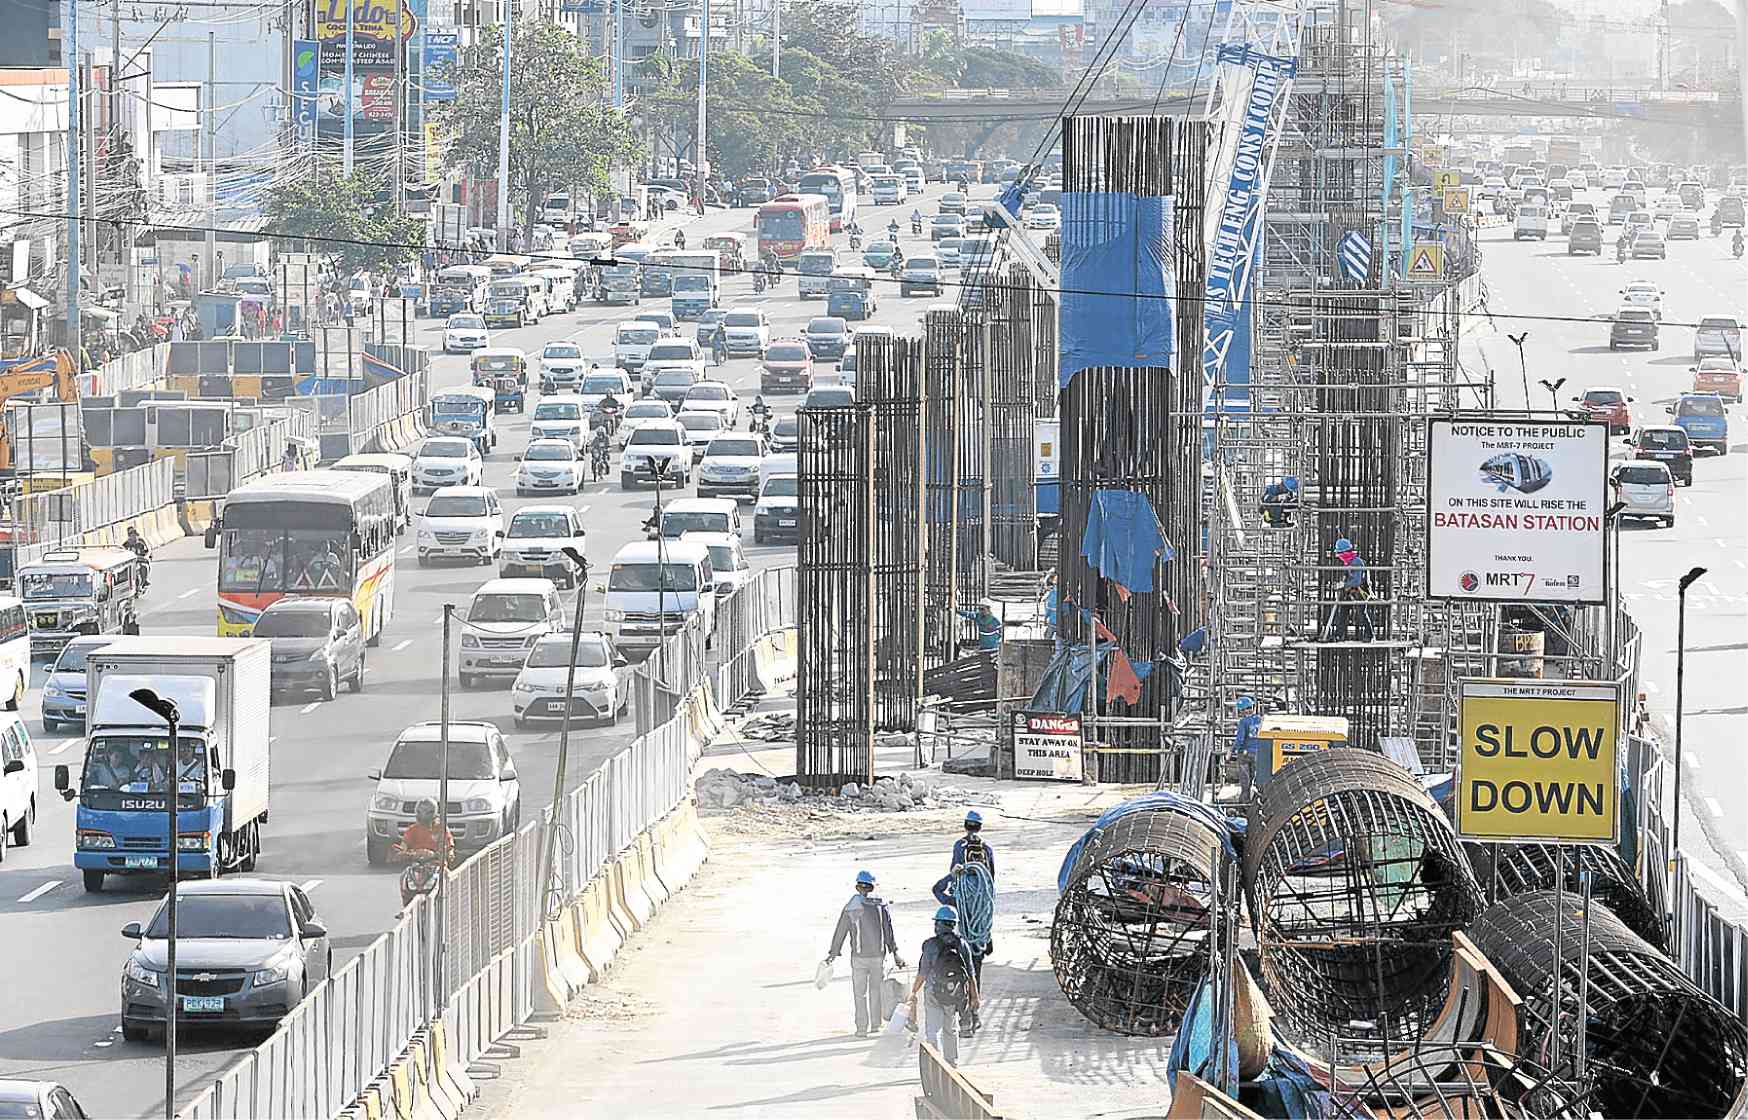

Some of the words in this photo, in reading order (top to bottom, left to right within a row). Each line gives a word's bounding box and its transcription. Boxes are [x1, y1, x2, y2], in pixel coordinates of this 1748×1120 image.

[326, 0, 386, 22] Ldo
[1451, 426, 1494, 437] NOTICE
[1498, 427, 1513, 437] TO
[1515, 427, 1538, 437] THE
[1541, 426, 1585, 438] PUBLIC
[1522, 442, 1554, 450] PROJECT
[1448, 498, 1463, 507] ON
[1466, 498, 1488, 507] THIS
[1490, 499, 1512, 508] SITE
[1514, 499, 1538, 509] WILL
[1541, 500, 1564, 509] RISE
[1566, 500, 1587, 510] THE
[1435, 512, 1518, 529] BATASAN
[1523, 514, 1599, 531] STATION
[1543, 688, 1576, 696] PROJECT
[1042, 738, 1066, 746] AWAY
[1474, 723, 1604, 760] SLOW
[1028, 749, 1047, 757] THIS
[1048, 750, 1070, 758] AREA
[1036, 769, 1054, 777] HOLE
[1471, 780, 1604, 816] DOWN
[122, 800, 166, 809] ISUZU
